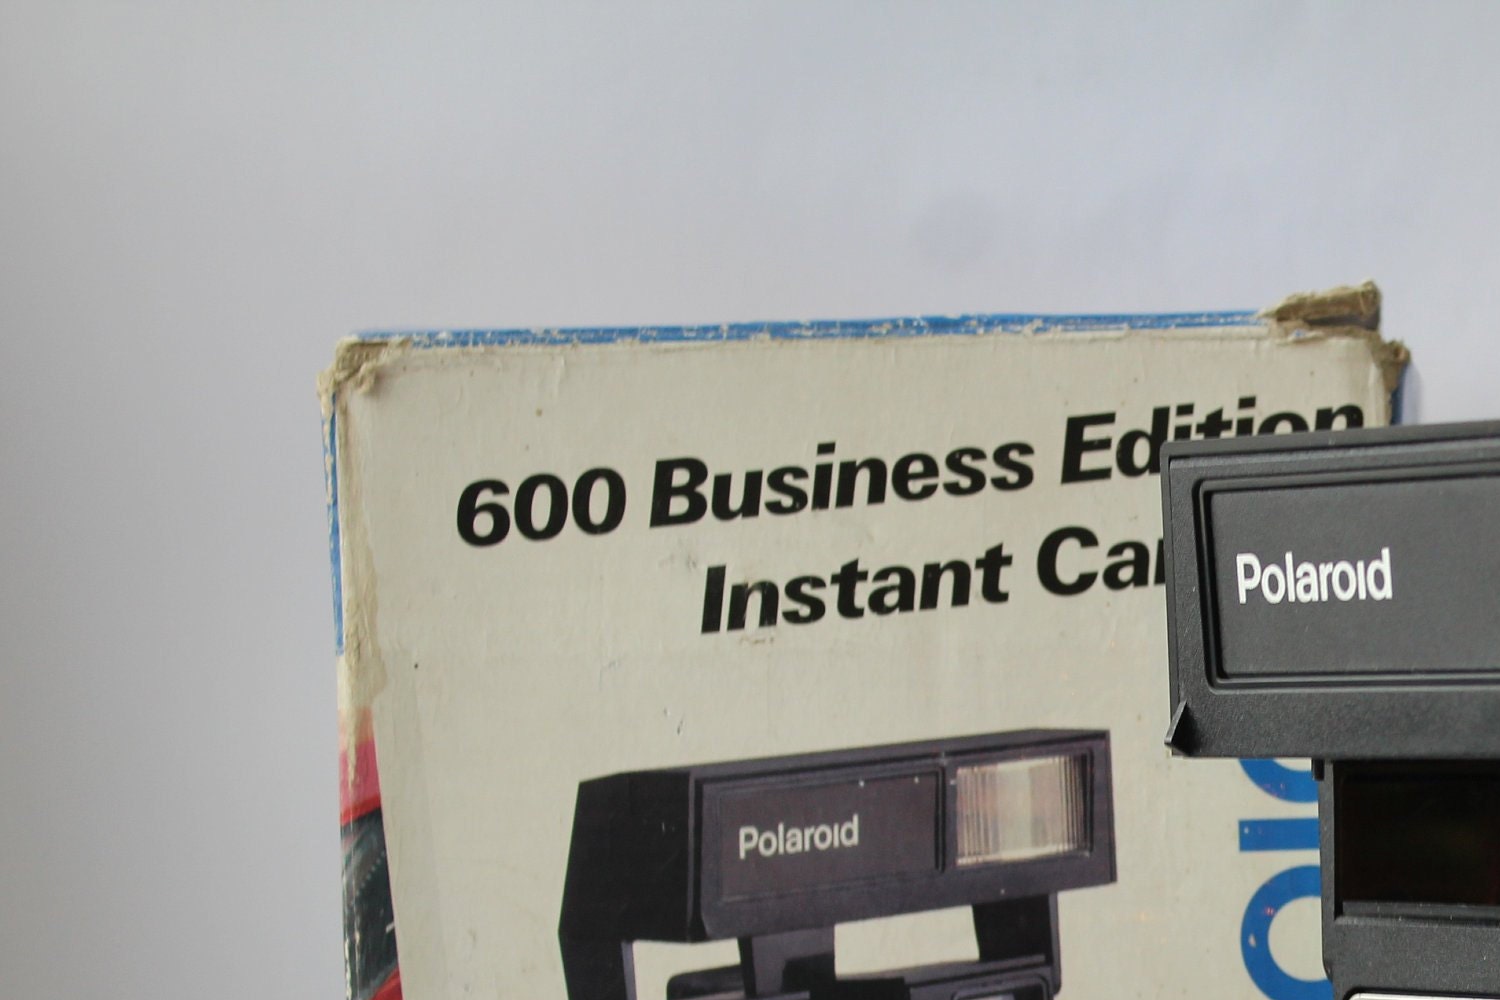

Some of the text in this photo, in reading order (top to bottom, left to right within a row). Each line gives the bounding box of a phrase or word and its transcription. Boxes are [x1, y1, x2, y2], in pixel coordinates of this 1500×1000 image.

[456, 472, 627, 548] 600
[649, 443, 1033, 529] Business
[700, 526, 1165, 635] Instant Ca
[1236, 547, 1393, 604] Polaroid
[739, 813, 859, 860] Polaroid
